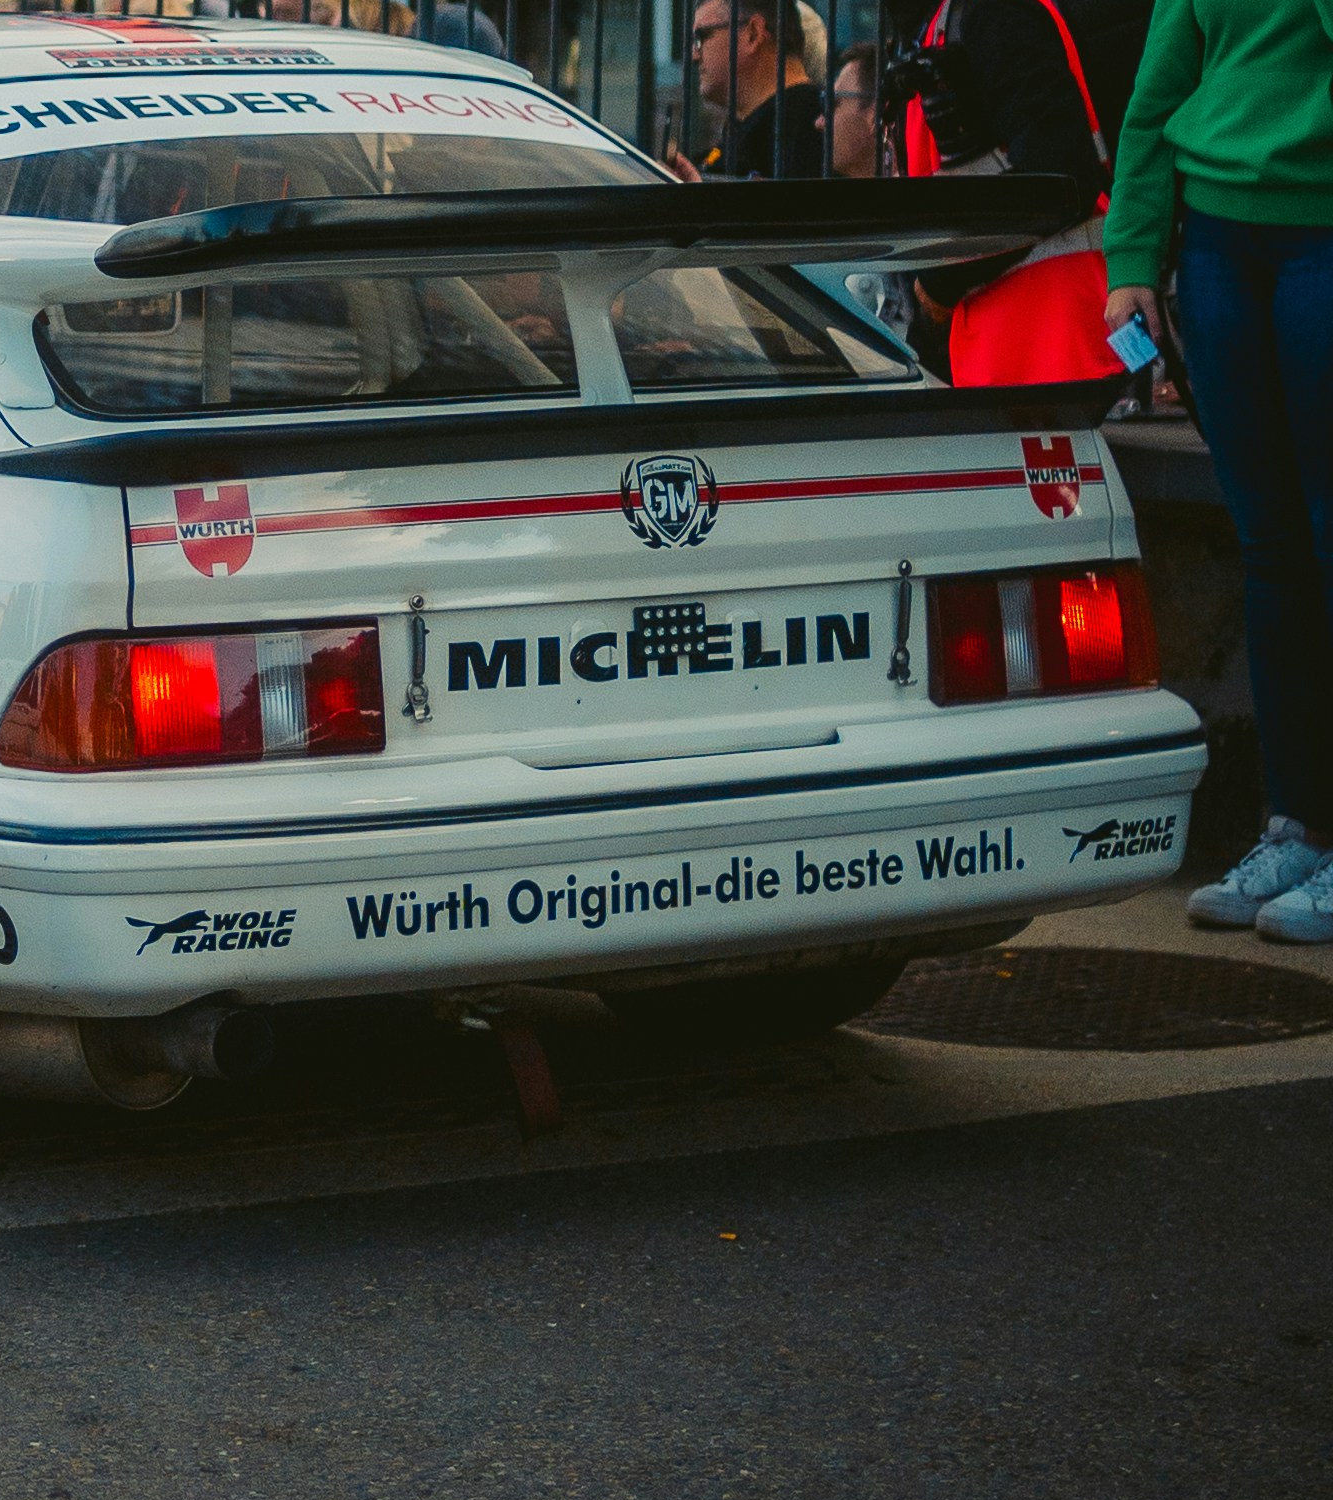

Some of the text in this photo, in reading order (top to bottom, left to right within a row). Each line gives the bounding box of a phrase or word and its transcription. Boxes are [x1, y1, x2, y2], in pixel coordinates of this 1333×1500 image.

[336, 91, 579, 129] RACING
[643, 478, 694, 521] GM
[1120, 814, 1177, 838] WOLF
[1094, 832, 1174, 860] RACING
[345, 826, 1026, 939] Würth Original-die beste Wahl.
[211, 908, 297, 934] WOLF
[172, 929, 294, 955] RACING
